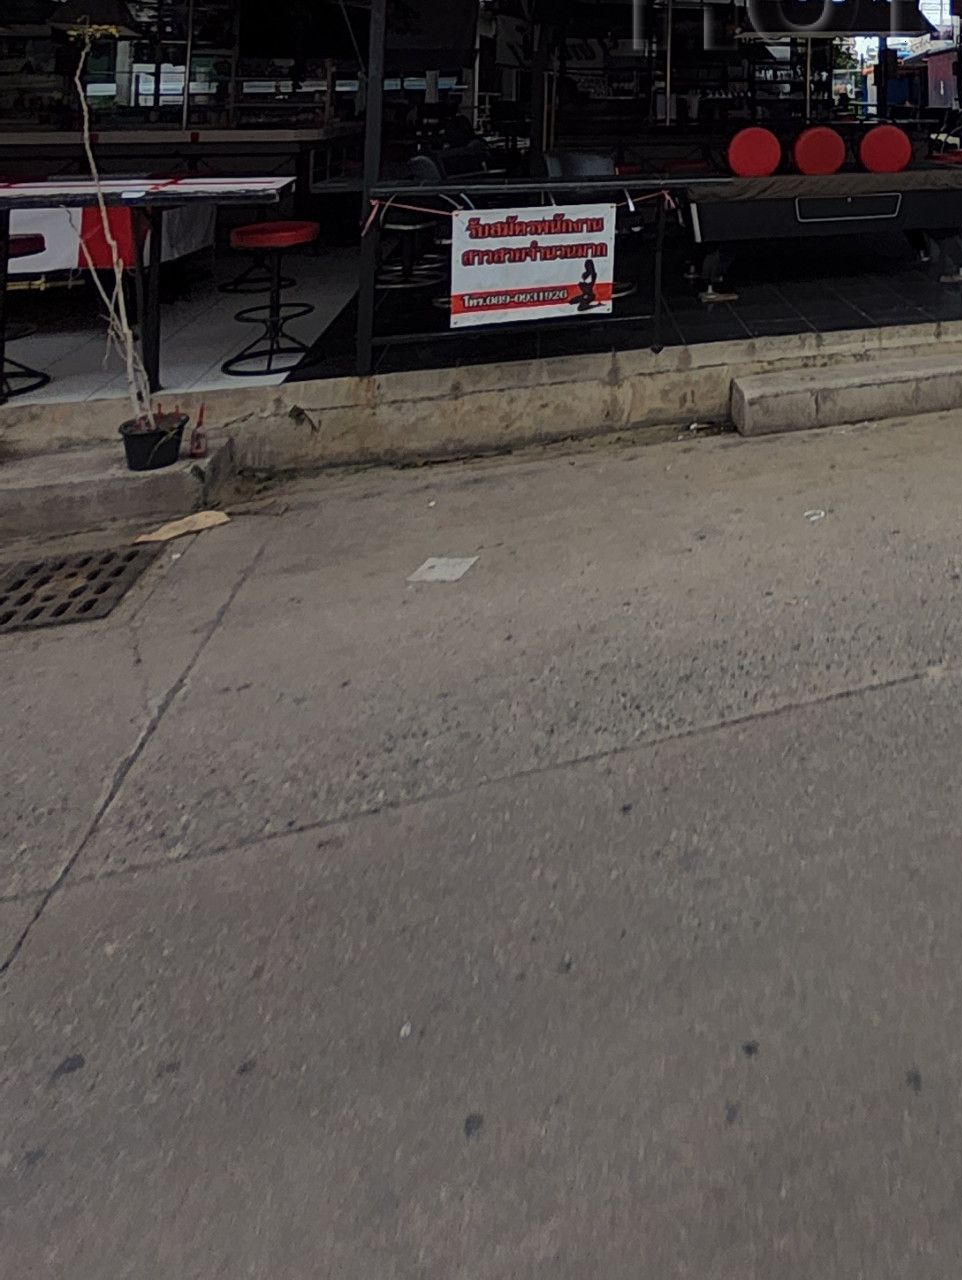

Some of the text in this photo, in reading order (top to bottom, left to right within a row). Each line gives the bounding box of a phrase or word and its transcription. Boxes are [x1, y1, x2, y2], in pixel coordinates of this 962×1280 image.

[467, 214, 604, 239] รับสมัครพนักงาน
